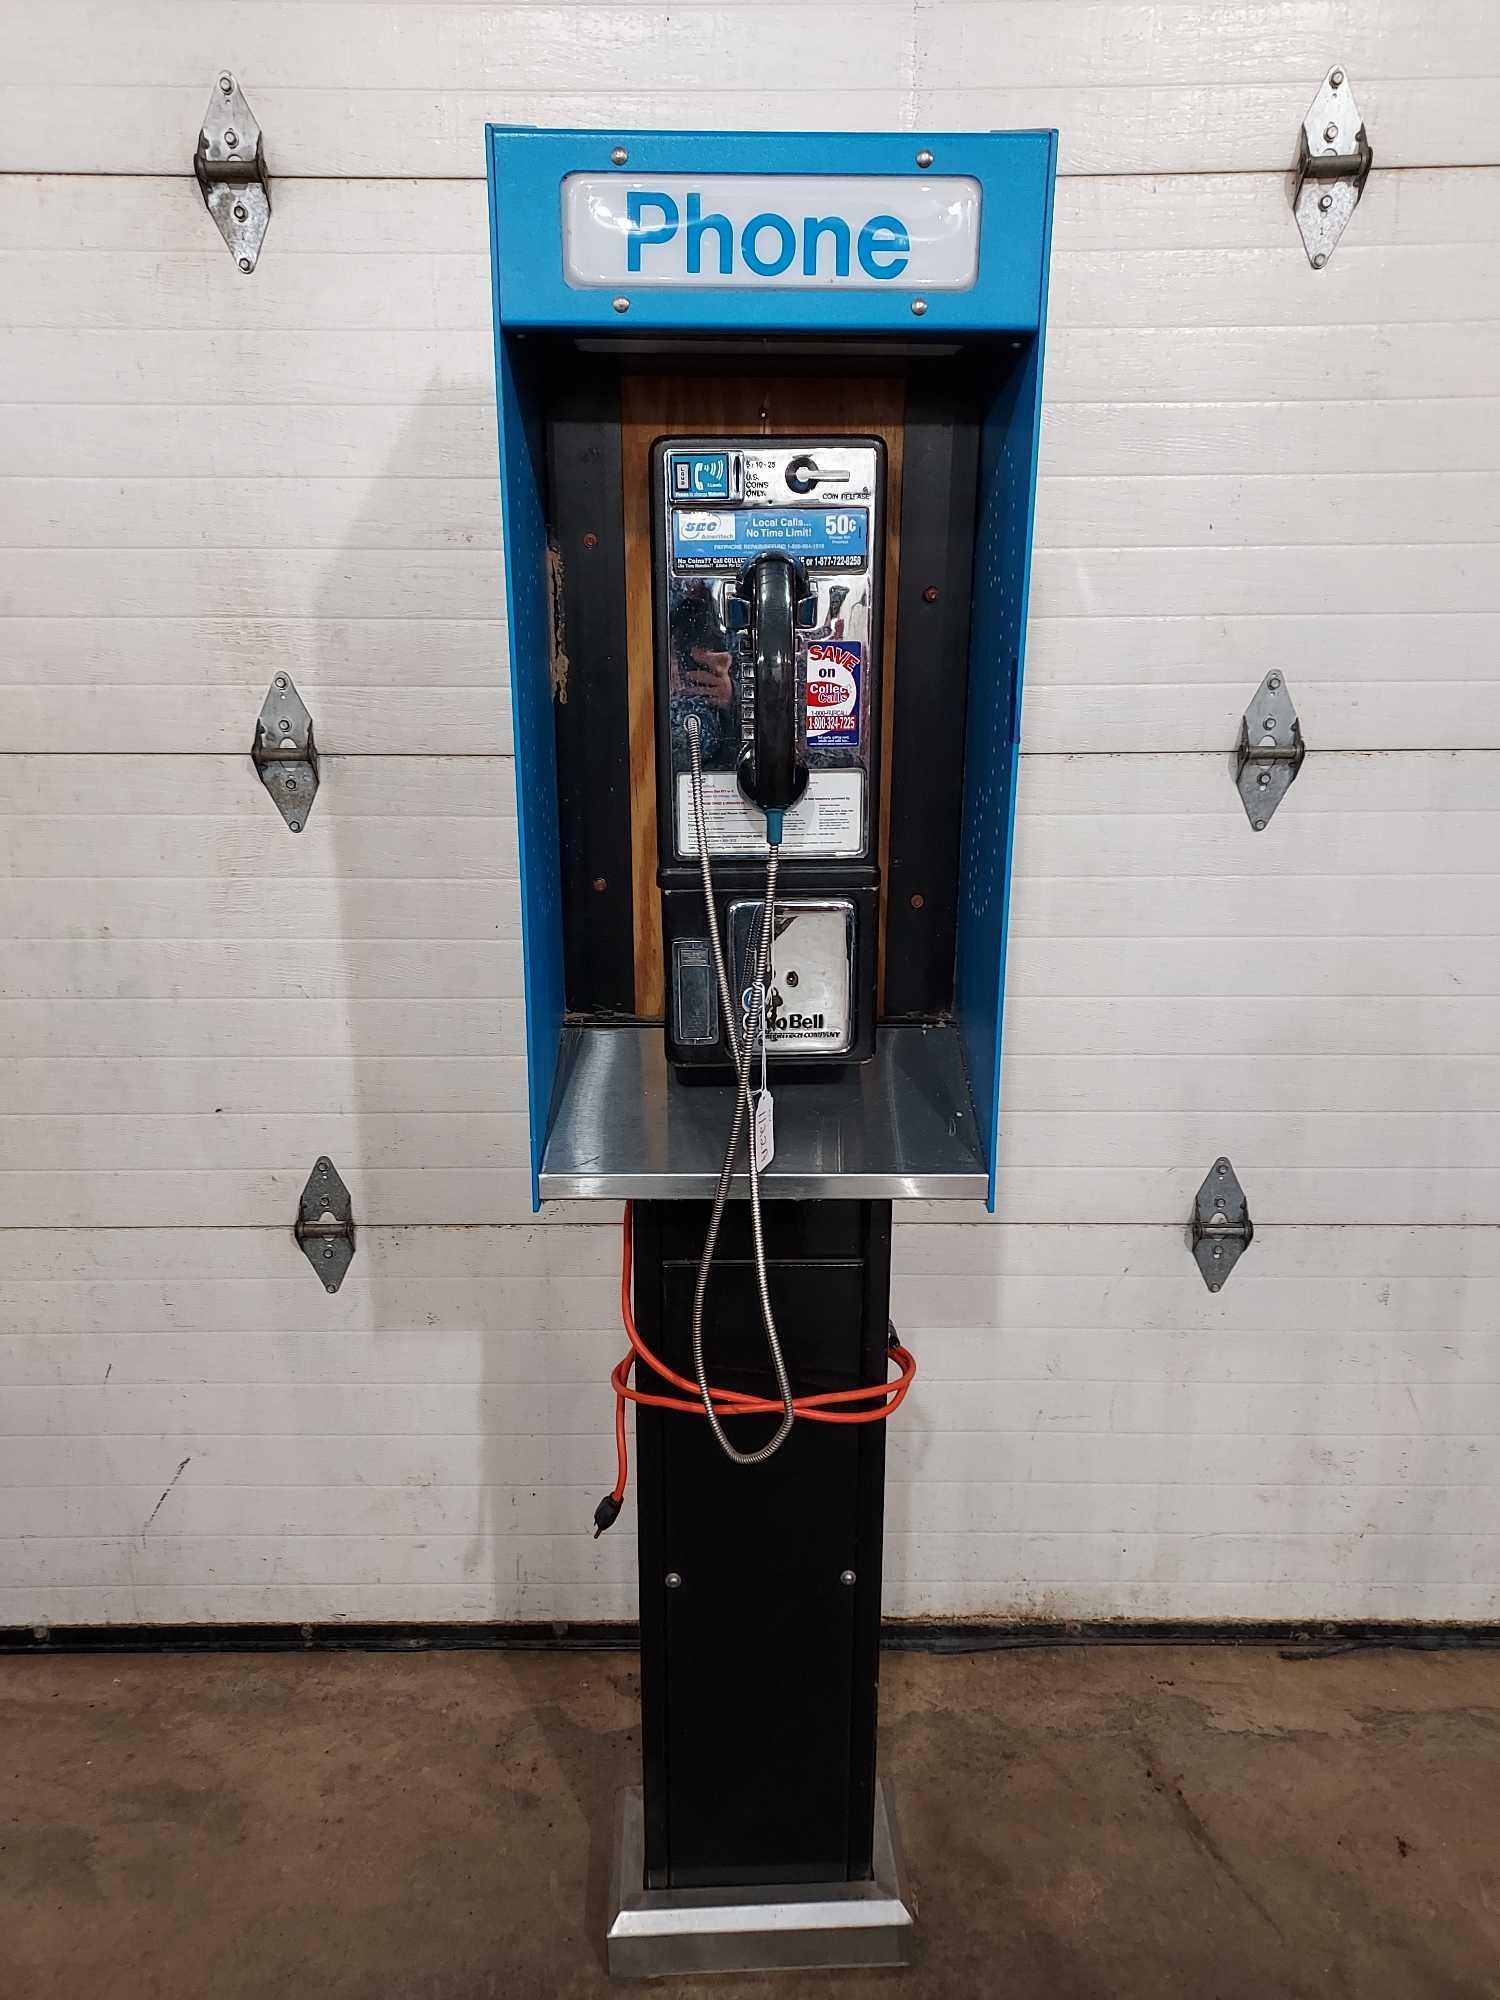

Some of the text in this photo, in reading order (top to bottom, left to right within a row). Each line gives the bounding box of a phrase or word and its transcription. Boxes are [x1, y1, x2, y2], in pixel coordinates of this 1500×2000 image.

[626, 191, 910, 280] Phone
[745, 481, 769, 489] COINS
[752, 517, 778, 527] Local
[746, 527, 812, 538] No Time Limit!
[713, 556, 724, 564] Call
[809, 645, 860, 672] SAVE
[818, 667, 836, 678] on
[817, 692, 849, 704] Calls
[789, 1013, 824, 1029] Bell
